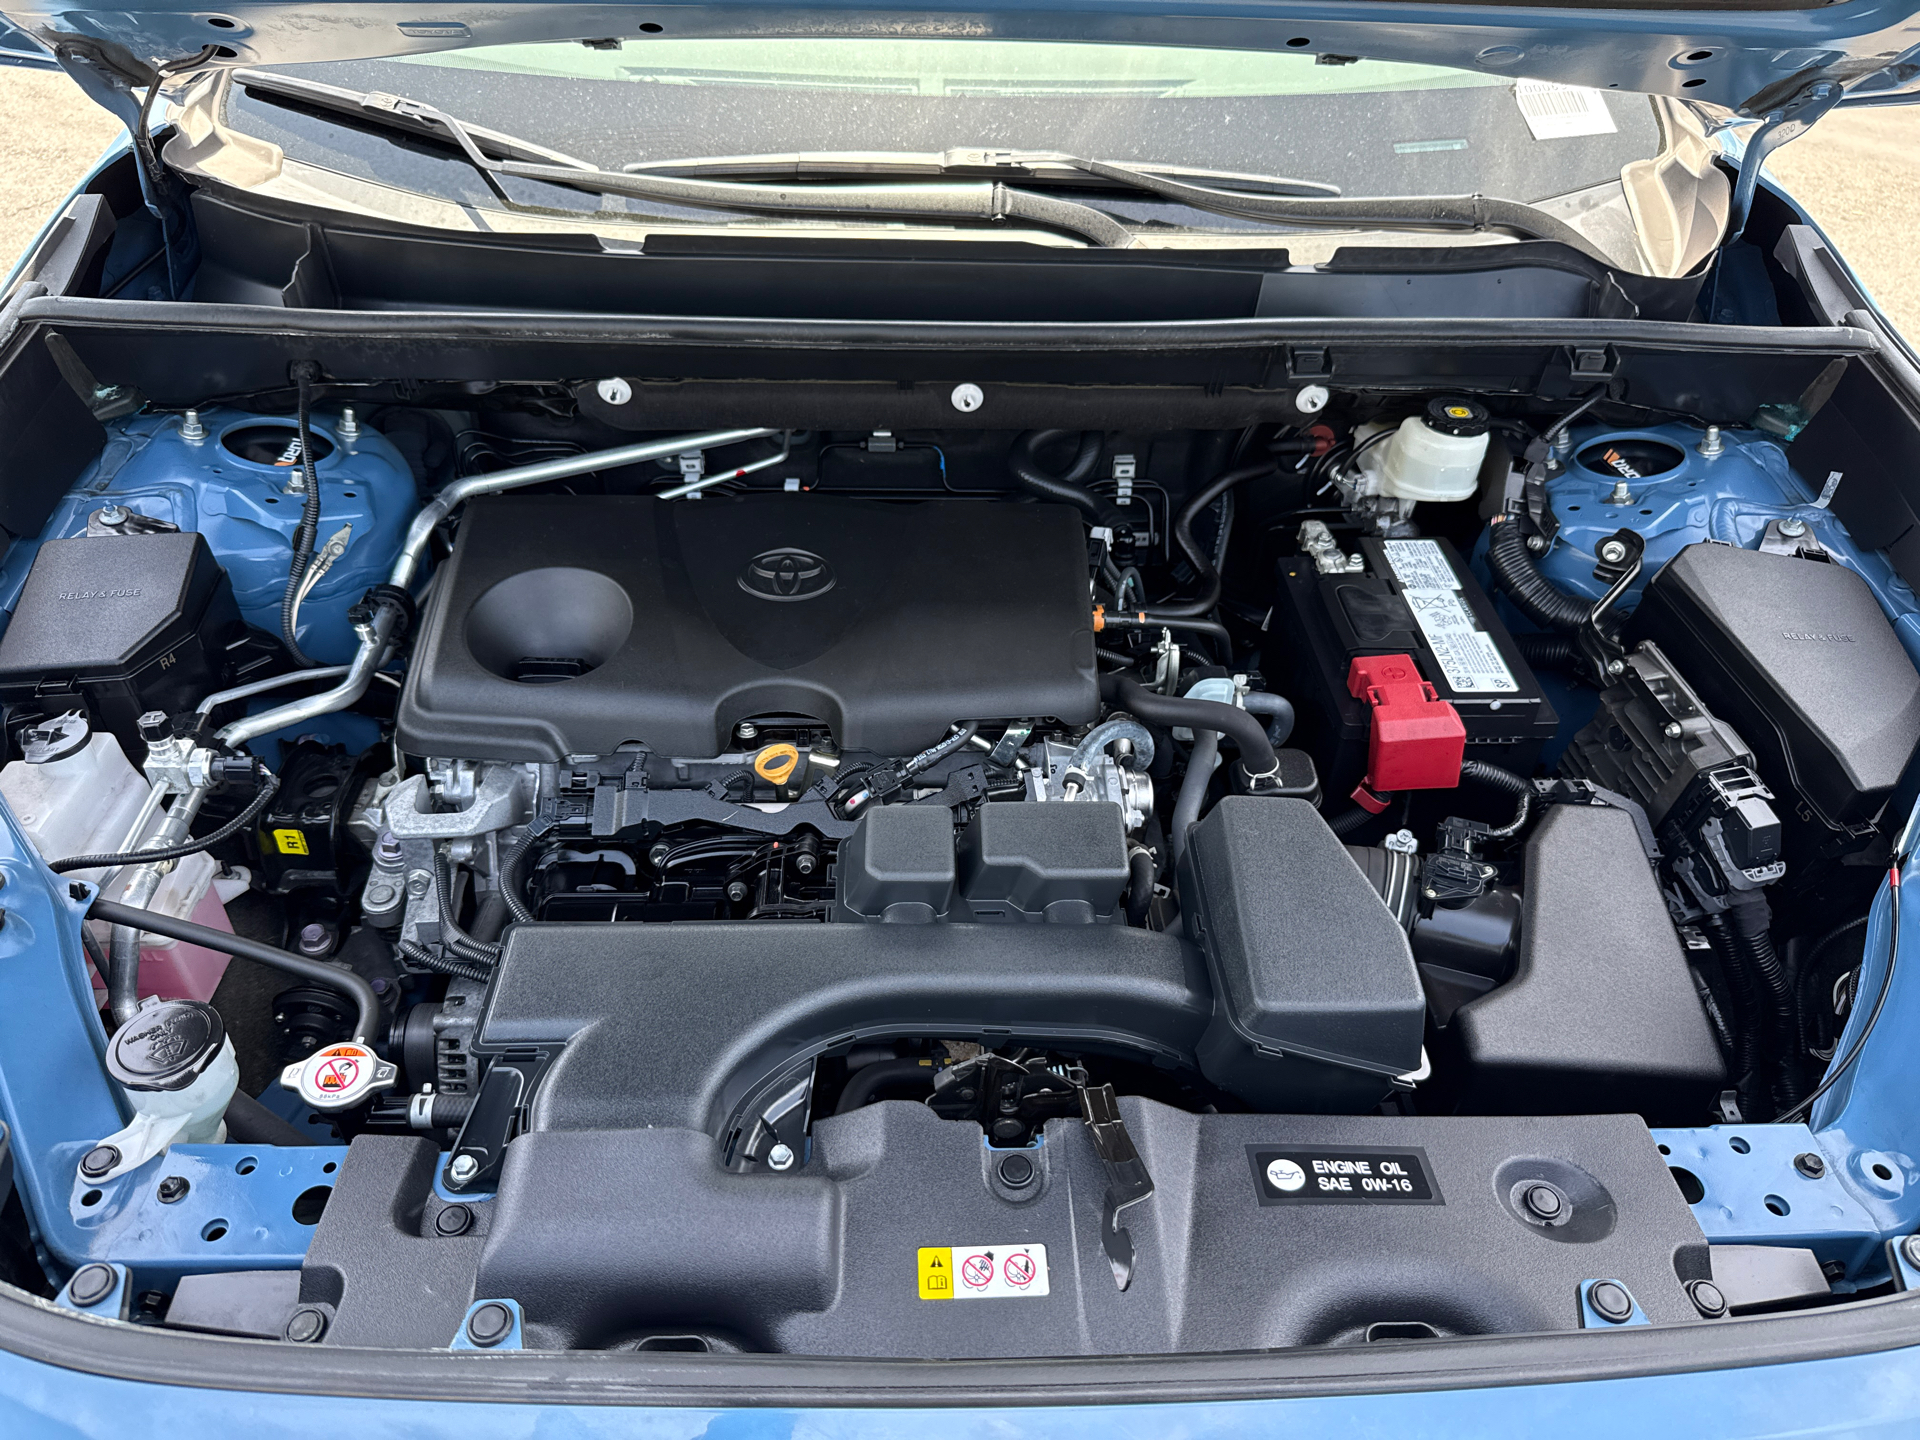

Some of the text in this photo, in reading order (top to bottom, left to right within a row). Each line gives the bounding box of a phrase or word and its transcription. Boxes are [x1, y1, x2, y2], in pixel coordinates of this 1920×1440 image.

[59, 588, 142, 600] RELAY & FUSE
[1781, 632, 1816, 641] RELAY
[1826, 634, 1856, 642] FUSE
[160, 652, 177, 670] R4
[1794, 800, 1813, 822] L5
[284, 835, 300, 849] R1
[1312, 1160, 1409, 1176] ENGINE OIL
[1317, 1177, 1413, 1193] SAE 0W-16
